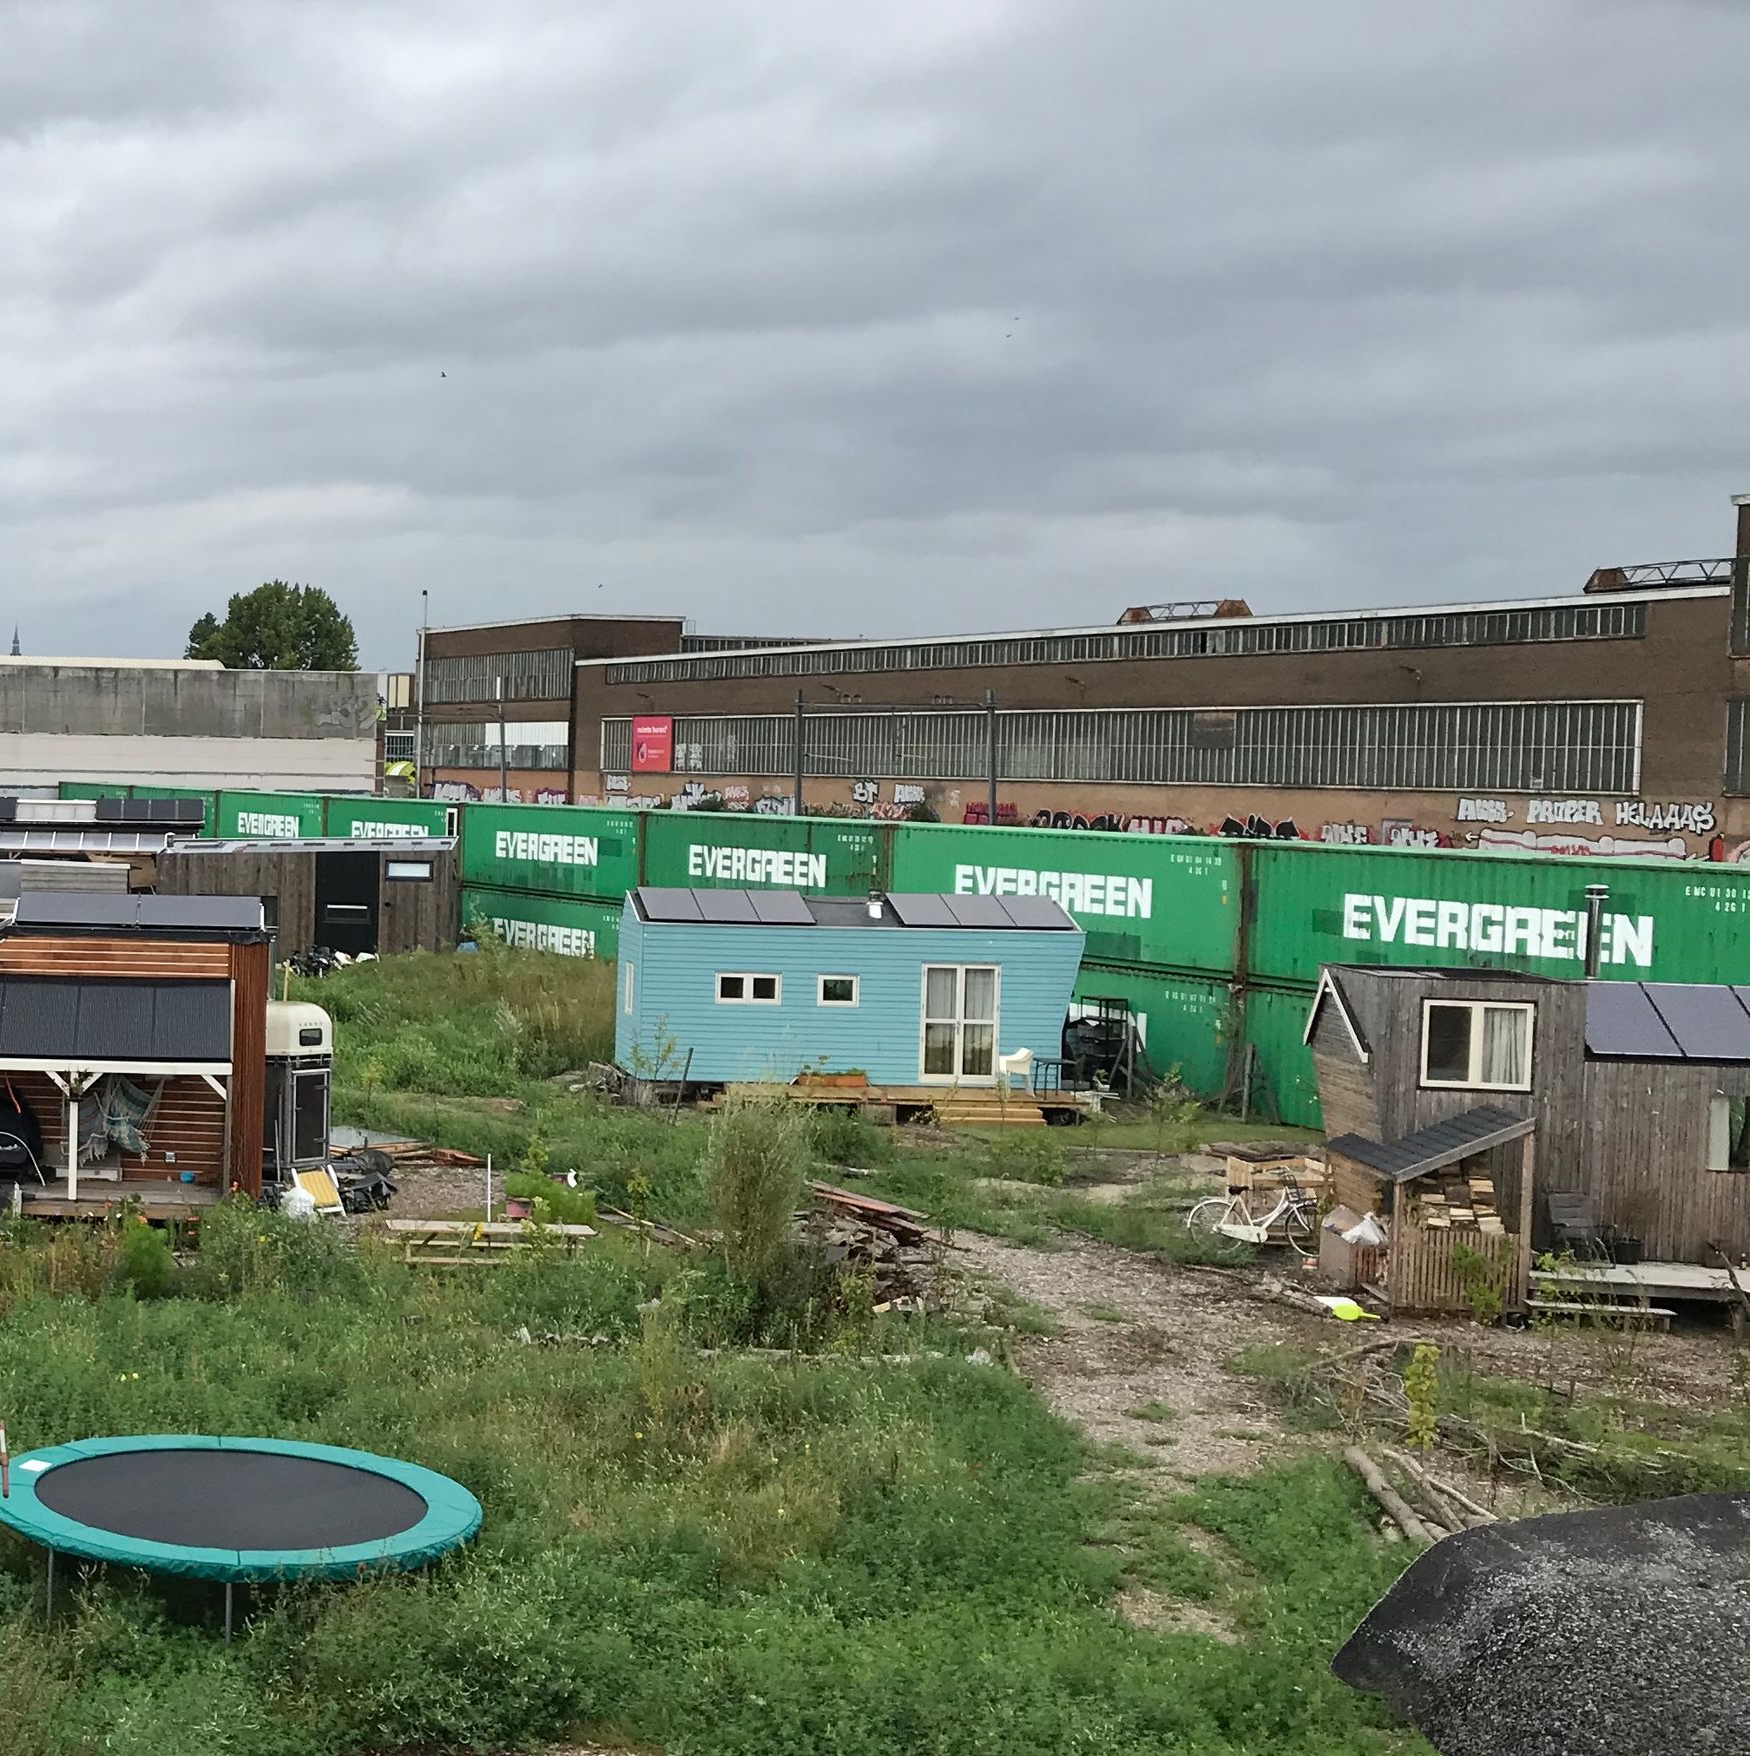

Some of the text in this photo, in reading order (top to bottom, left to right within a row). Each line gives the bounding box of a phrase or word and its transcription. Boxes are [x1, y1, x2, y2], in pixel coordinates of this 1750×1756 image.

[238, 811, 299, 837] EVERGREEN
[1526, 799, 1604, 826] PROPER
[1615, 801, 1716, 835] HELAAAS
[495, 830, 598, 866] EVERGREEN
[688, 844, 827, 888] EVERGREEN
[954, 864, 1153, 919] EVERGREEN
[1343, 893, 1654, 968] EVERGREEN
